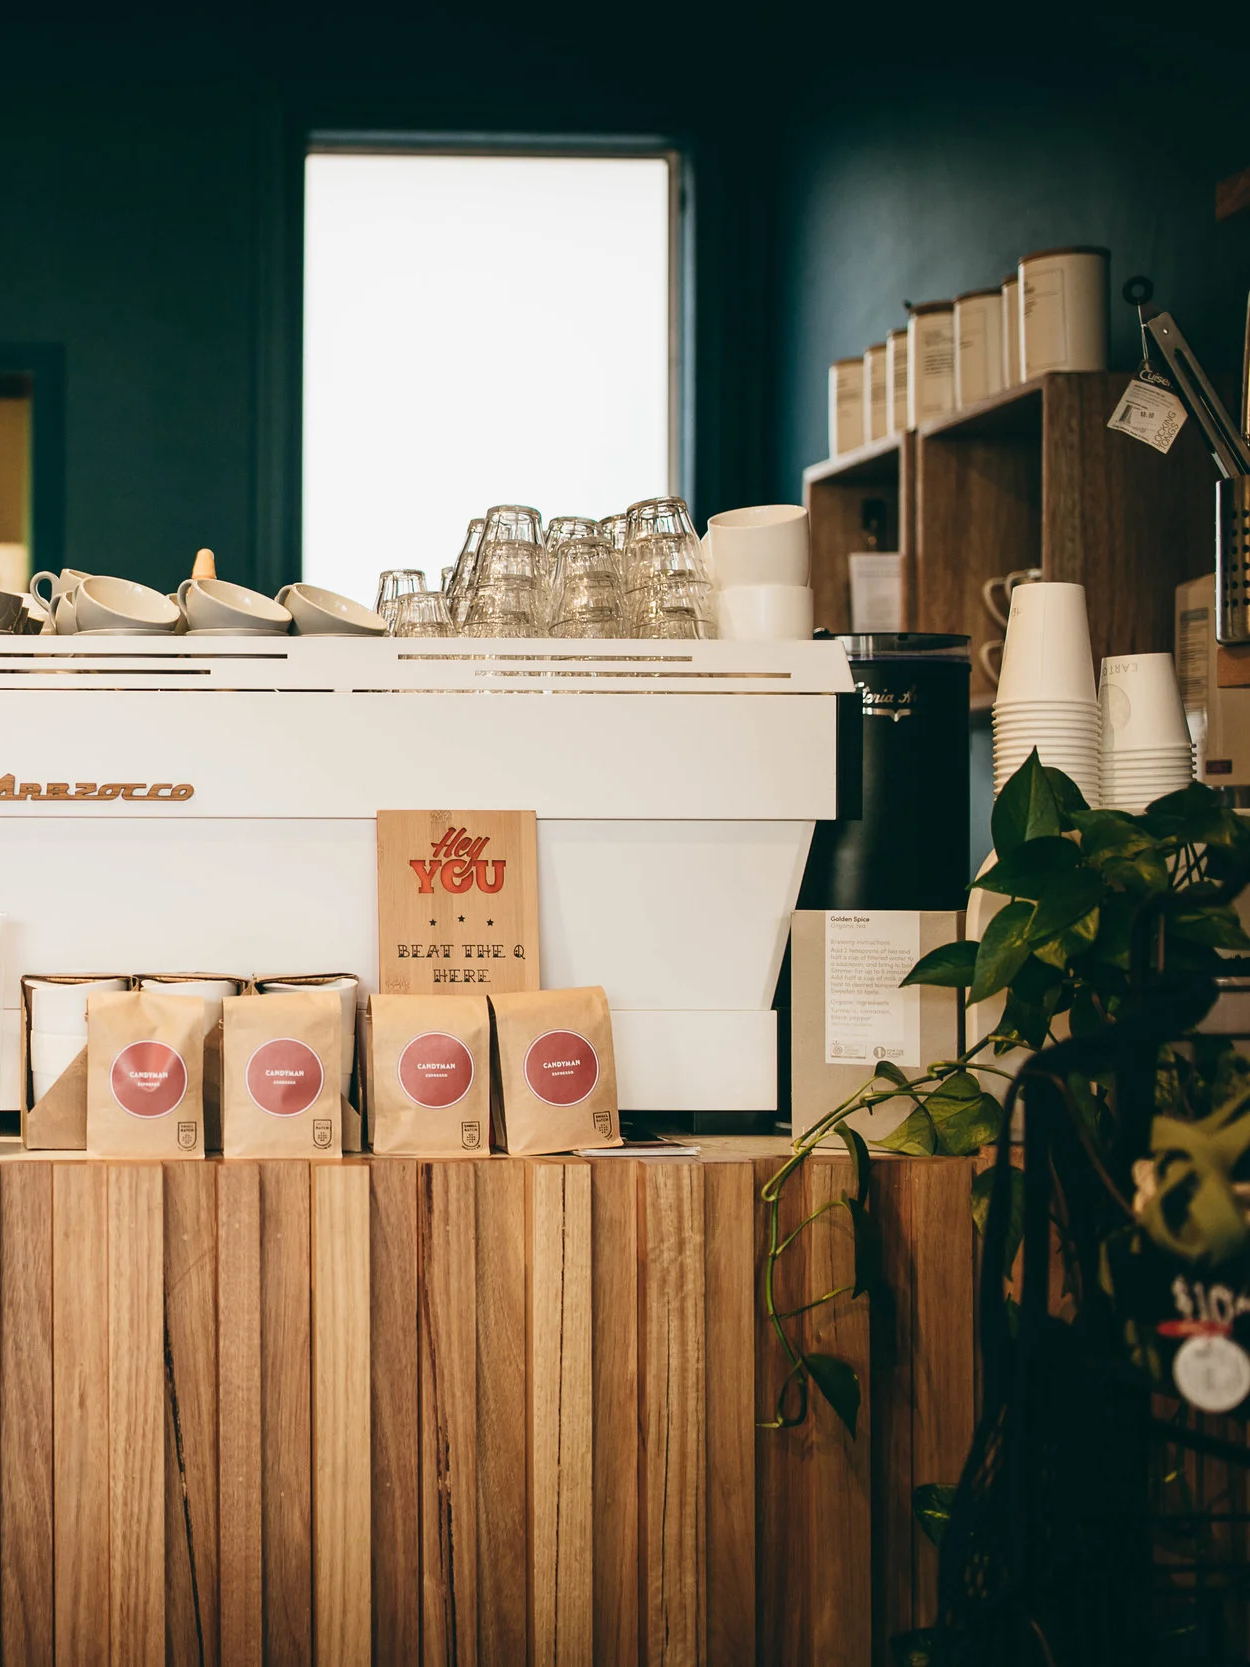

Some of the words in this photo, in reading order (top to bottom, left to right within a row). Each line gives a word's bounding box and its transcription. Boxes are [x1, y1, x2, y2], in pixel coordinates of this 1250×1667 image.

[1152, 410, 1176, 446] LOCKING
[1160, 423, 1180, 450] TONGS
[1102, 662, 1138, 676] CARTO
[431, 827, 490, 878] Hey
[409, 859, 506, 894] YOU
[398, 944, 454, 958] BEAT
[462, 944, 506, 958] THE
[513, 944, 526, 960] Q
[433, 968, 492, 982] HERE
[543, 1060, 580, 1069] CANDYMAN
